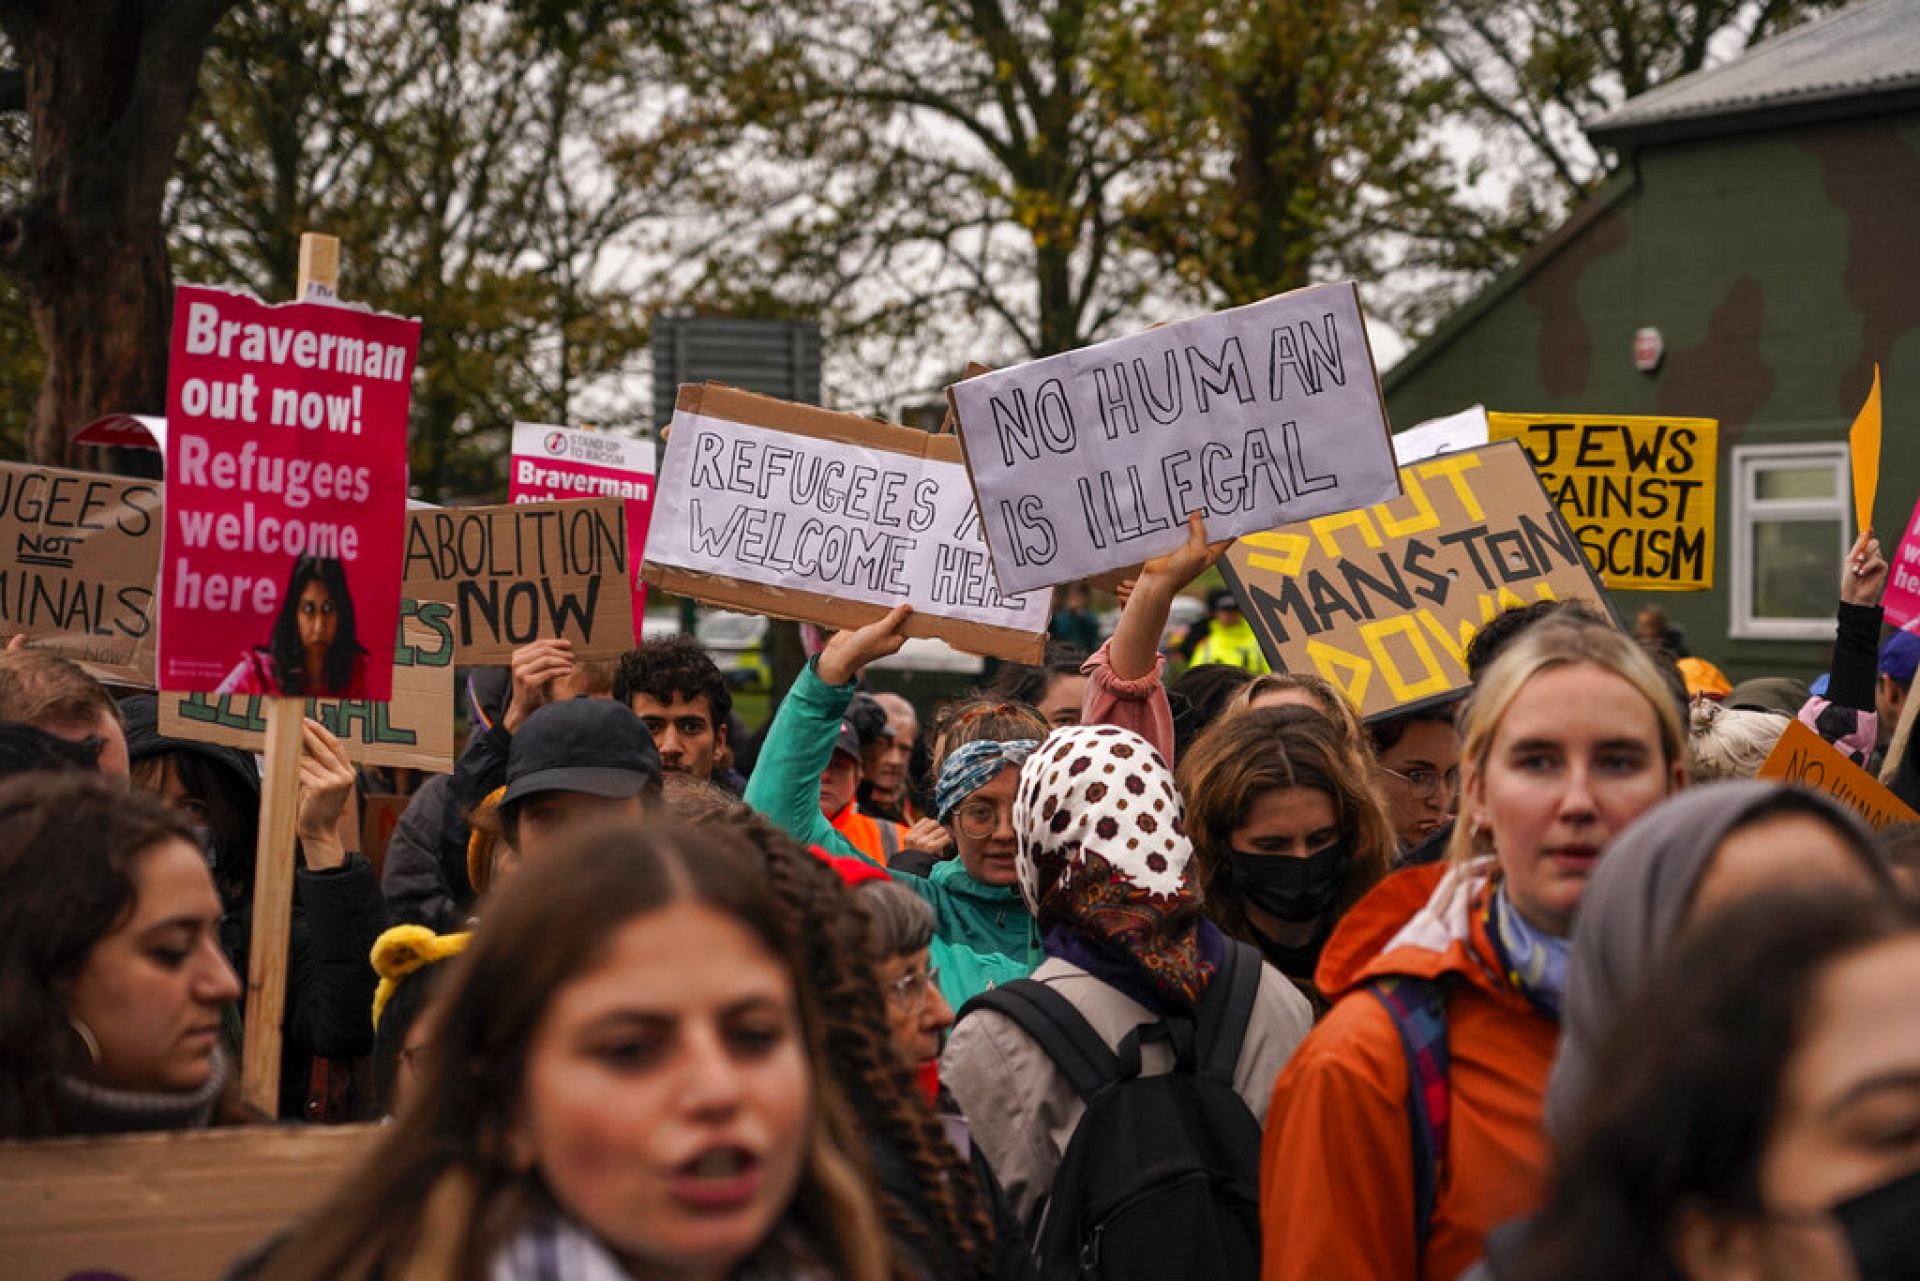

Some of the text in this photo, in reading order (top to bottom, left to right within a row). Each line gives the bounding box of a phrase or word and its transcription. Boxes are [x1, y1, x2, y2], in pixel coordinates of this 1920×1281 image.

[186, 302, 407, 382] Braverman
[181, 373, 364, 435] out now!
[990, 313, 1346, 467] NO HUMAN
[178, 434, 371, 508] Refugees
[517, 460, 649, 502] Braverman
[691, 432, 940, 533] REFUGEES
[1526, 424, 1698, 474] JEWS
[178, 501, 360, 560] welcome
[1000, 495, 1058, 567] IS
[1078, 421, 1338, 550] ILLEGAL
[17, 533, 84, 555] NOT
[403, 505, 625, 581] ABOLITION
[689, 498, 918, 597] WELCOME
[931, 543, 1027, 611] HER
[1249, 510, 1580, 644] MANSTON
[173, 556, 278, 615] here
[457, 575, 600, 647] NOW
[1785, 747, 1825, 787] NO
